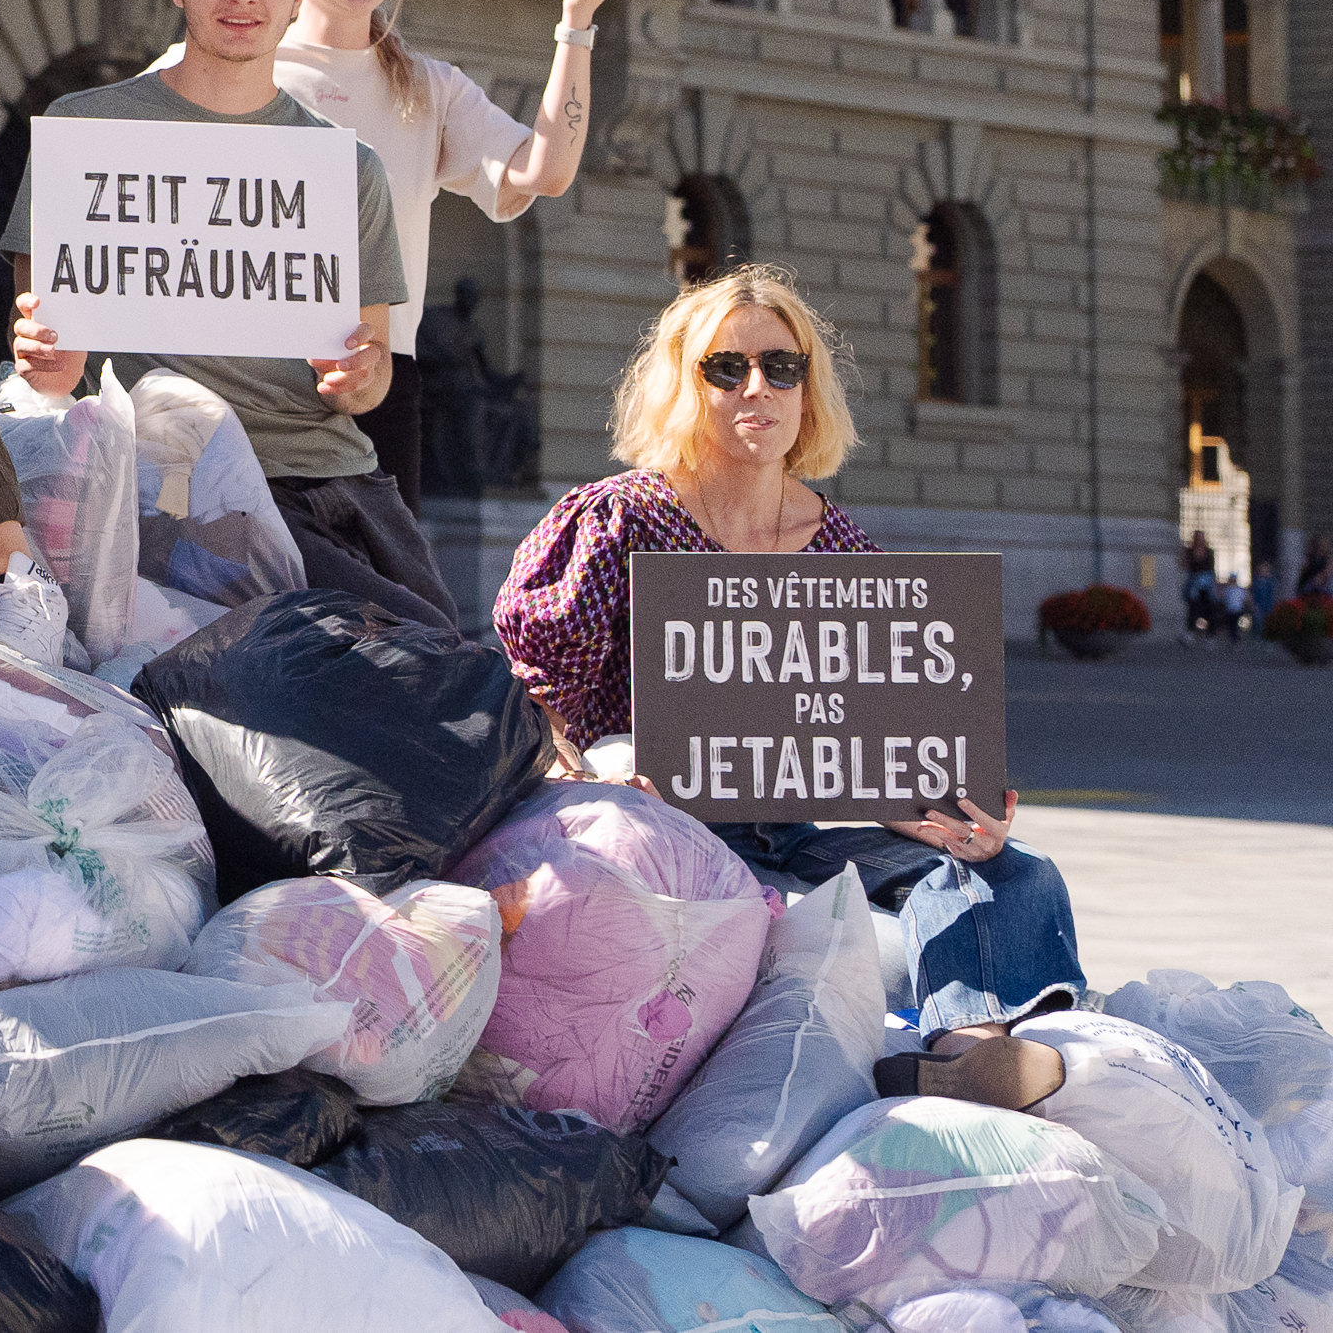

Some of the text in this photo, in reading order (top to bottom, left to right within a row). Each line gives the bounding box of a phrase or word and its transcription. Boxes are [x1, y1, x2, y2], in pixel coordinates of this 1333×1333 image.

[85, 173, 306, 229] ZEIT ZUM
[51, 239, 340, 303] AUFRÄUMEN
[708, 571, 928, 608] DES VÊTEMENTS
[664, 620, 974, 692] DURABLES,
[795, 693, 844, 724] PAS
[672, 735, 968, 799] JETABLES!
